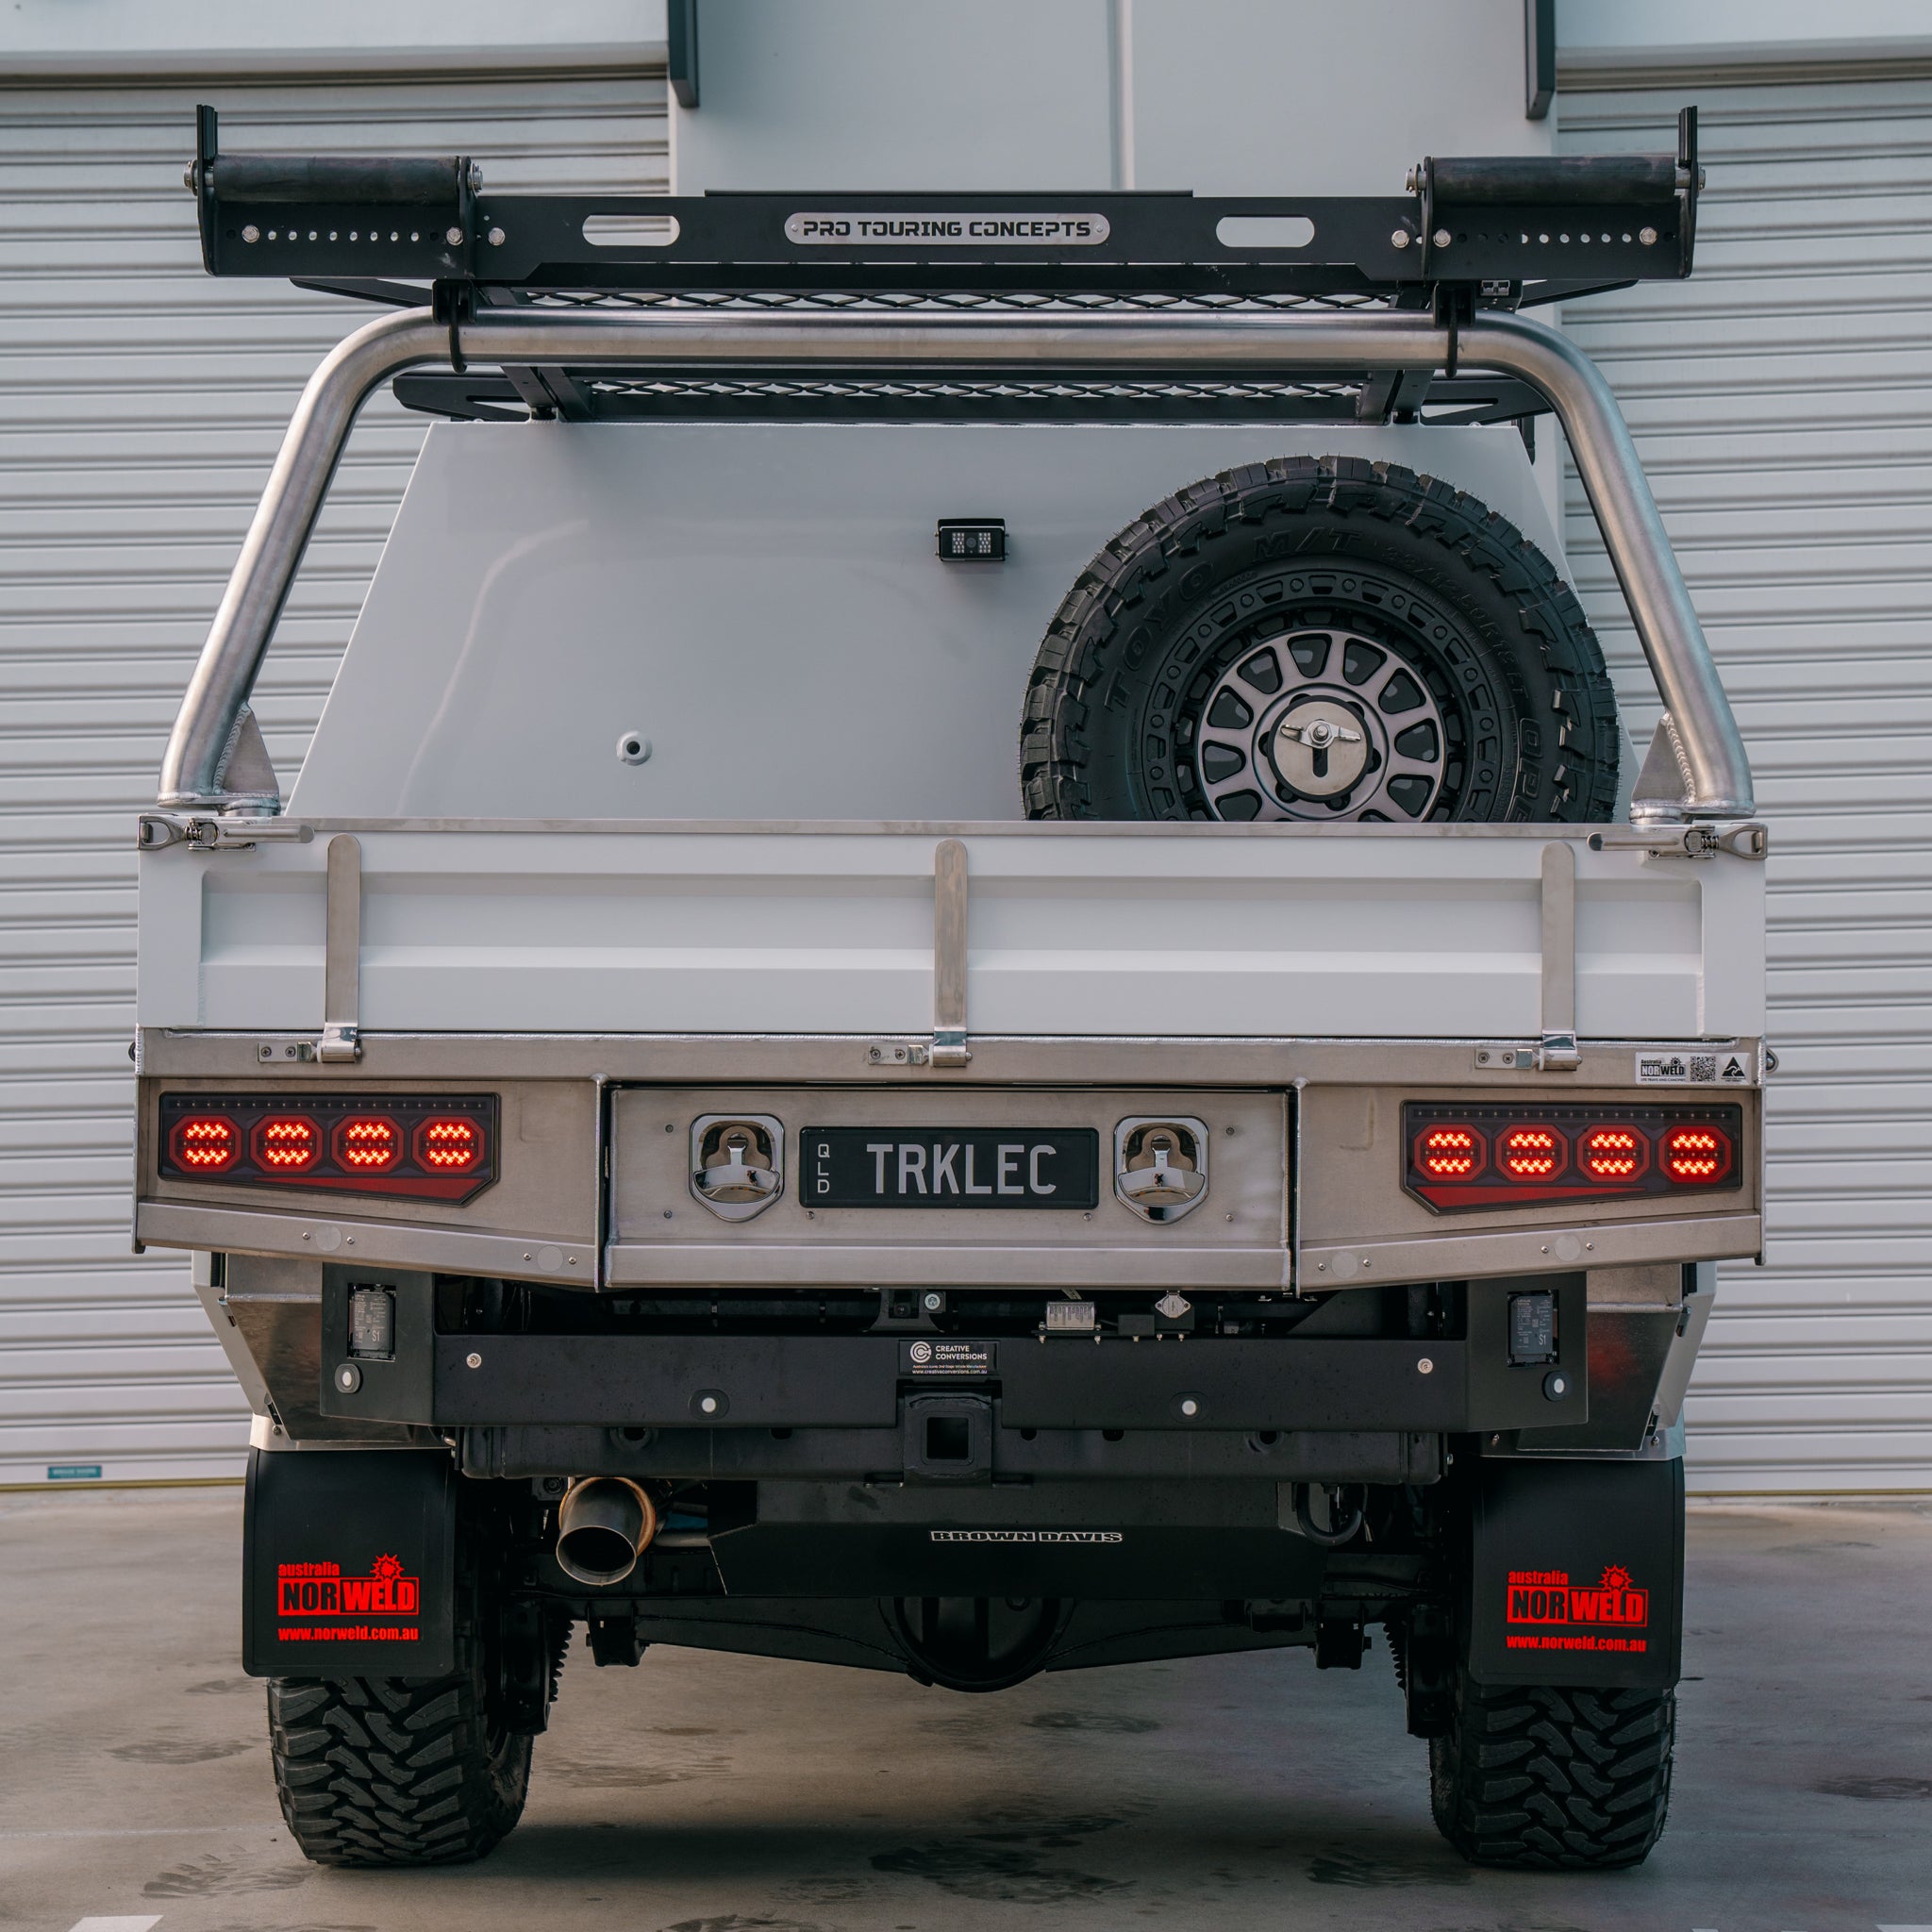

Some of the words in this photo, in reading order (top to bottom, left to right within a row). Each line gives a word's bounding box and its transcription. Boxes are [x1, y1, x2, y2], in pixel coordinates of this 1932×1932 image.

[802, 221, 851, 237] PRO
[858, 221, 963, 237] TOURING
[969, 221, 1091, 237] CONCEPTS
[1252, 527, 1365, 560] M/T
[1103, 560, 1214, 711] TOYO
[1641, 1064, 1685, 1076] NORWELD
[866, 1143, 1058, 1195] TRKLEC
[930, 1530, 1037, 1541] BROWN
[1039, 1531, 1124, 1543] DAVIS
[277, 1561, 341, 1576] australia
[1507, 1569, 1569, 1586] australia
[282, 1580, 417, 1612] NORWELD
[1511, 1589, 1645, 1623] NORWELD
[277, 1624, 419, 1641] www.norweld.com.au
[1506, 1634, 1647, 1653] www.norweld.com.au
